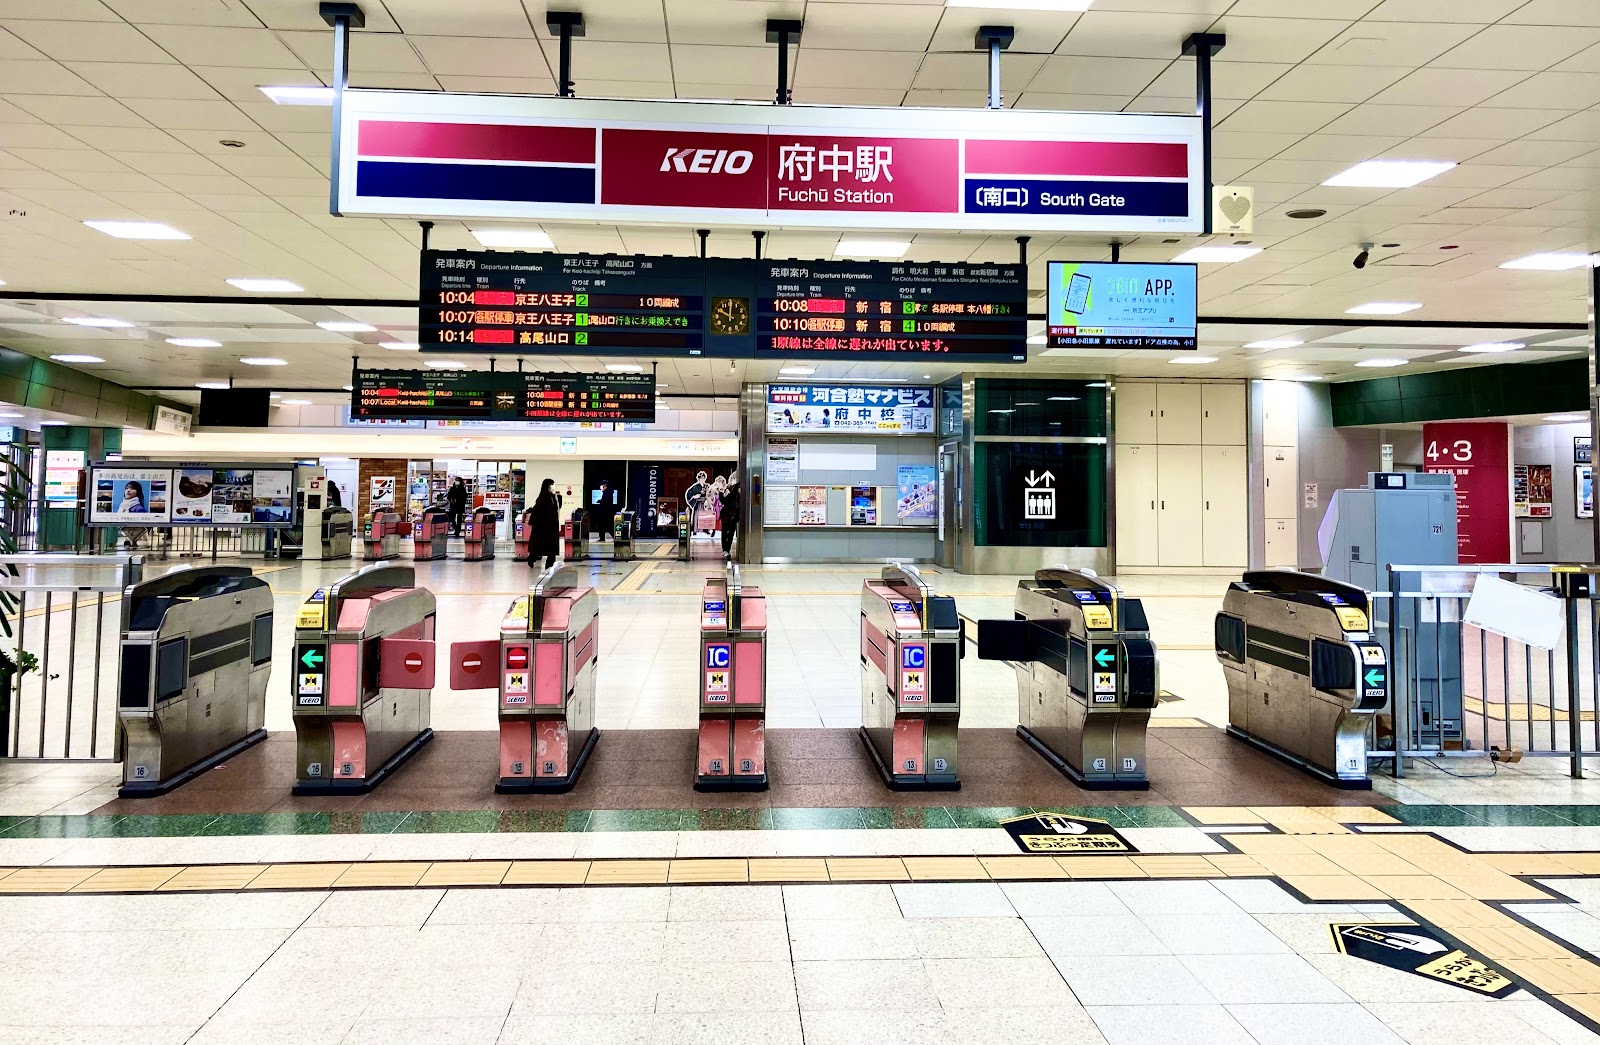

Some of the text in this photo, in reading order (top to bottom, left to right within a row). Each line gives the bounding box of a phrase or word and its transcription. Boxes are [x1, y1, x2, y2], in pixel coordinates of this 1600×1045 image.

[660, 148, 753, 174] KEIO
[777, 143, 894, 183] 府中駅
[778, 187, 894, 204] Fuchū Station
[1040, 193, 1084, 207] South
[1089, 193, 1125, 207] Gate
[436, 258, 476, 270] 発車案内
[563, 259, 599, 267] 京王八王子
[605, 260, 634, 268] 高尾山口
[770, 267, 808, 278] 発車案内
[1144, 278, 1175, 296] APP.
[439, 291, 475, 304] 10:04
[515, 293, 575, 306] 京王八王子
[578, 295, 586, 306] 2
[773, 299, 808, 312] 10:08
[438, 310, 475, 323] 10:07
[475, 311, 514, 324] 各駅停車
[515, 313, 574, 326] 京王八王子
[773, 317, 808, 331] 10:10
[438, 329, 474, 343] 10:14
[520, 331, 569, 344] 高尾山口
[577, 333, 586, 344] 2
[812, 387, 930, 404] 河合塾マナビス
[649, 469, 657, 506] PRONTO
[708, 647, 728, 667] IC
[903, 648, 923, 667] IC
